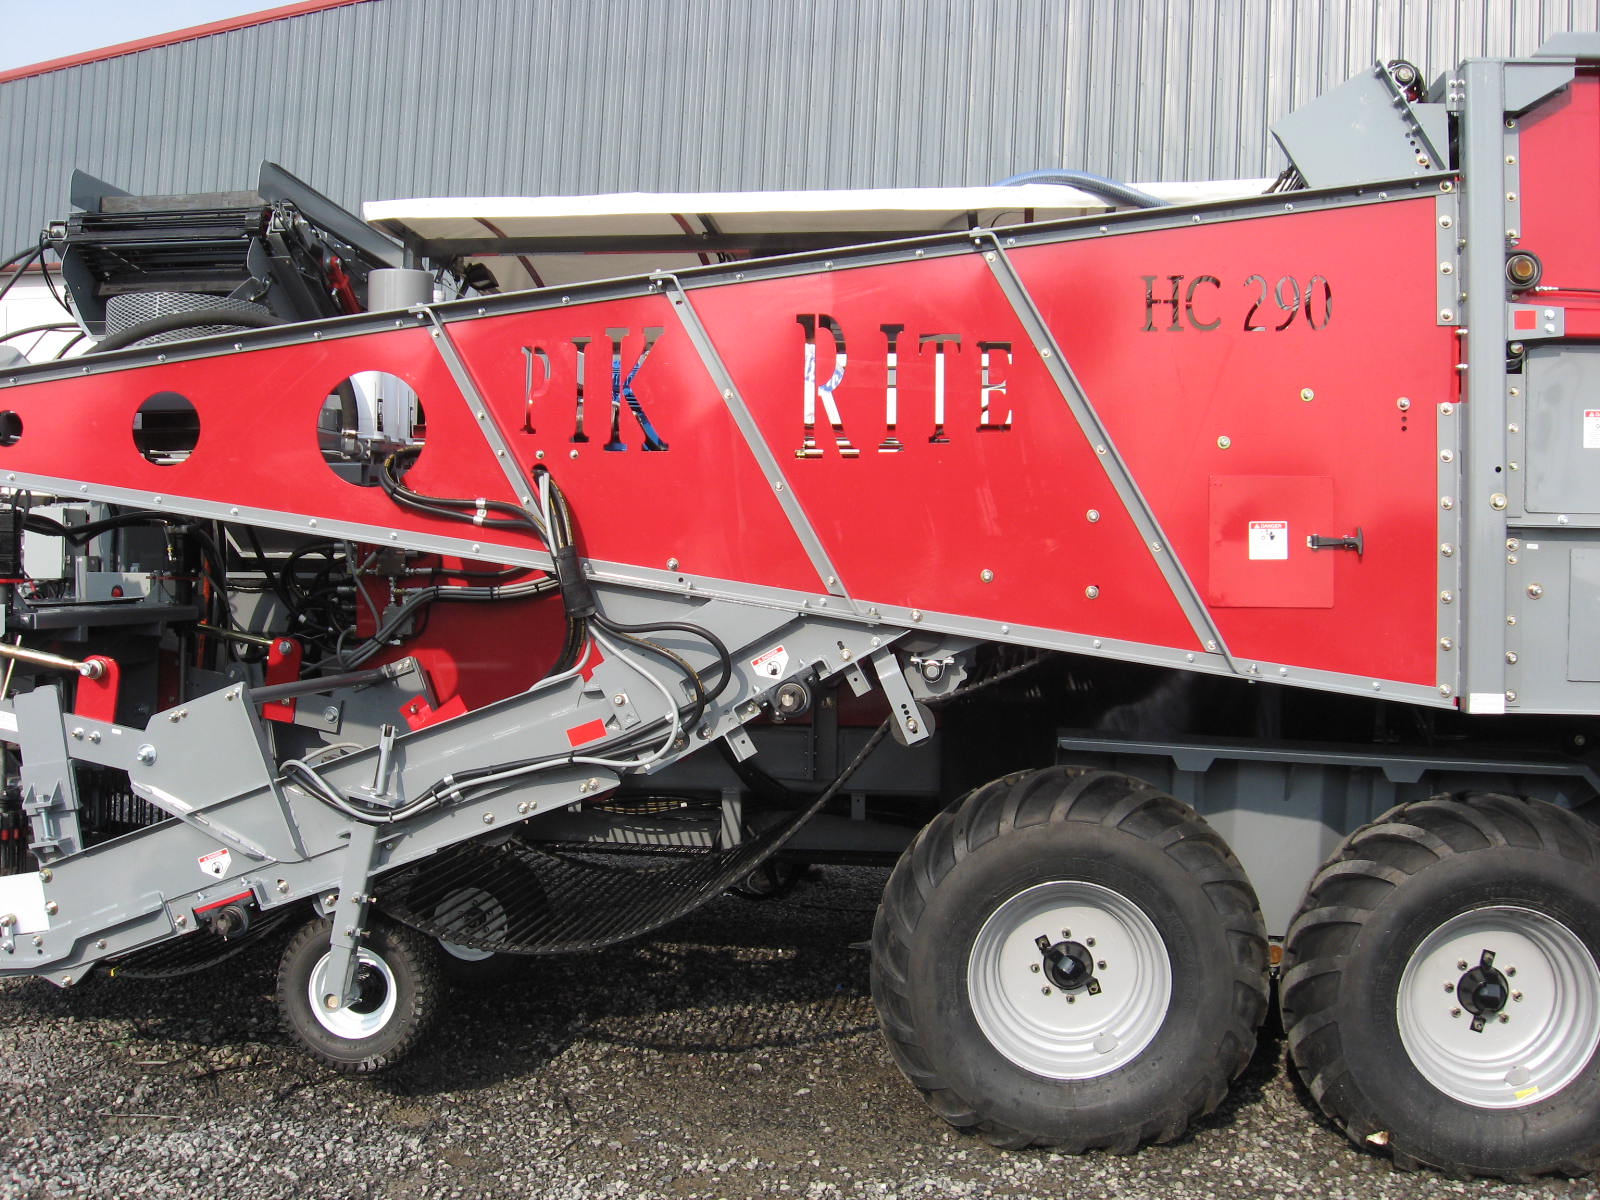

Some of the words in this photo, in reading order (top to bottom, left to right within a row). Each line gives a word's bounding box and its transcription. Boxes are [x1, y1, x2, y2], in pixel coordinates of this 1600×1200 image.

[1140, 275, 1221, 331] HC
[1244, 274, 1332, 331] 290
[520, 326, 669, 451] PIK
[795, 314, 1012, 458] RITE
